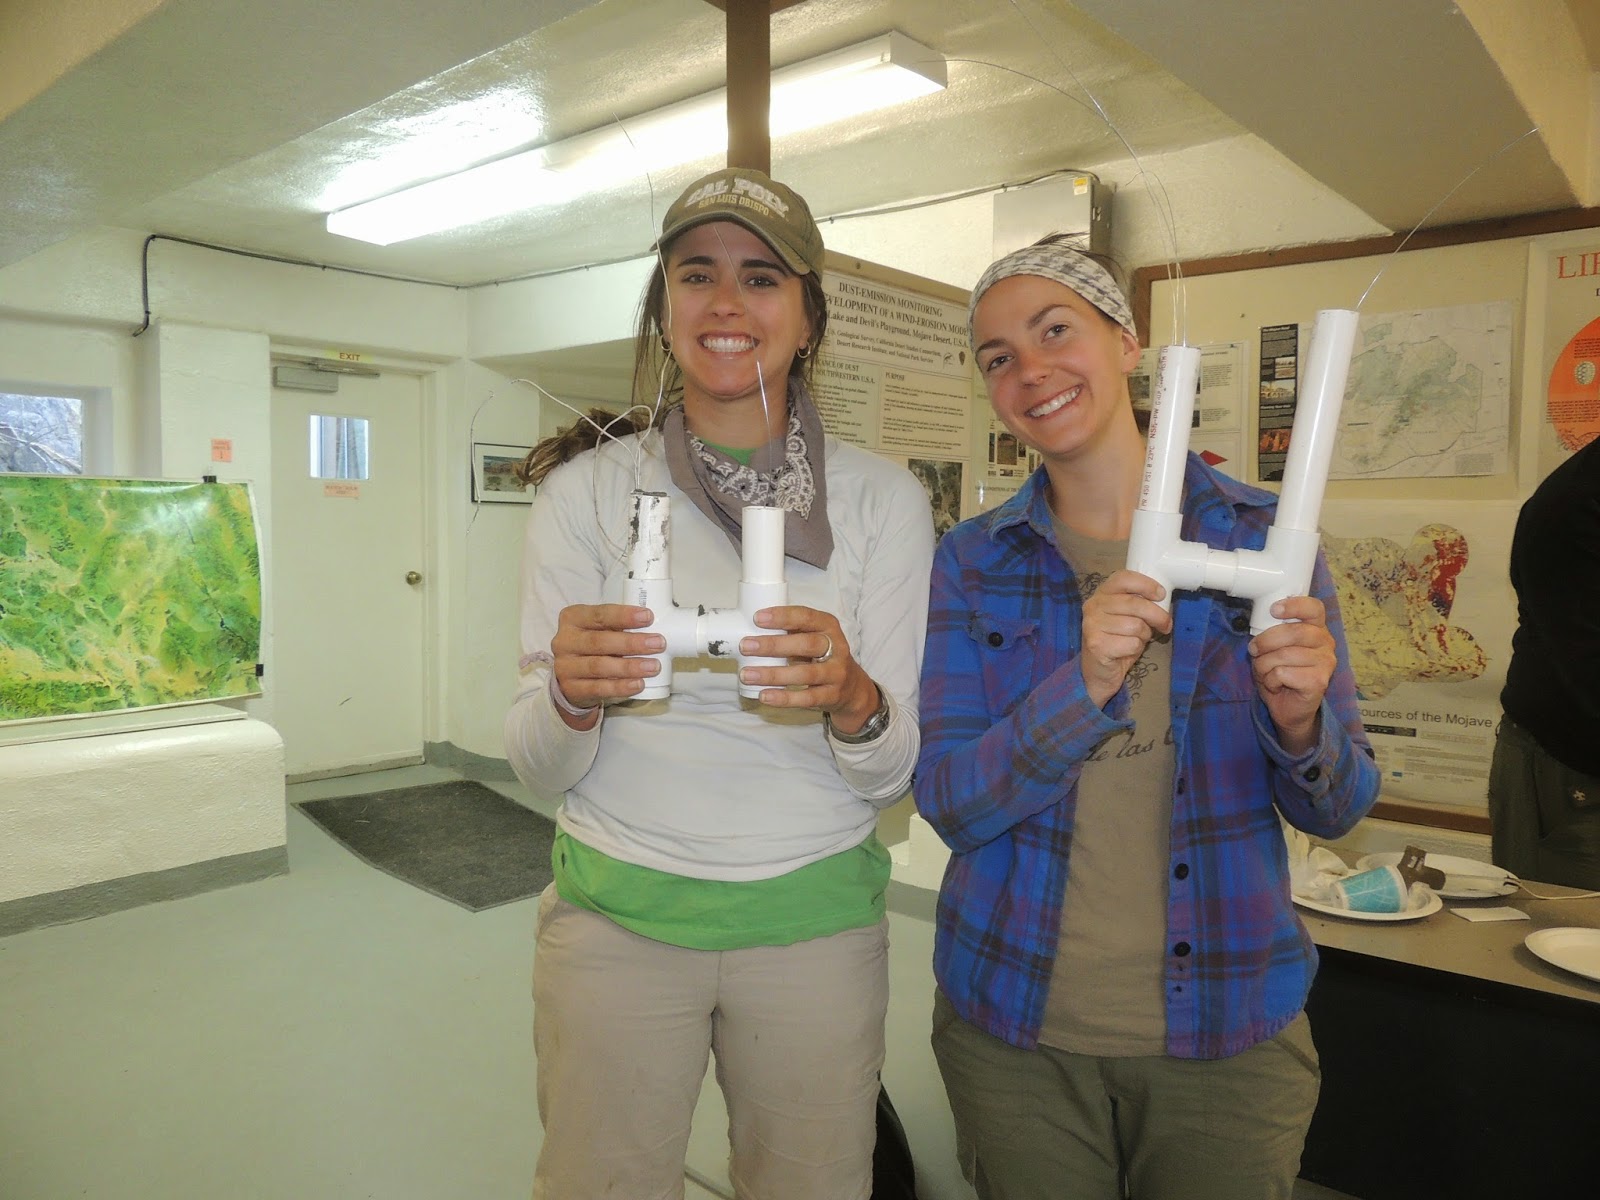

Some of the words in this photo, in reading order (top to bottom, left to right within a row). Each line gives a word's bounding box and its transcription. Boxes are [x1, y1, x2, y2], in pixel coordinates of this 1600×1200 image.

[698, 197, 716, 208] SAN
[716, 194, 738, 204] LUIS
[739, 196, 770, 216] OBISPO
[839, 281, 896, 305] DUST-EMISSION
[846, 315, 858, 325] and
[860, 316, 880, 329] Devil's
[912, 328, 932, 341] Mojave
[880, 307, 888, 318] OF
[890, 311, 895, 320] A
[896, 311, 947, 331] WIND-EROSION
[339, 352, 361, 361] EXIT
[1406, 710, 1418, 721] of
[1422, 711, 1441, 723] the
[1445, 713, 1493, 728] Mojave
